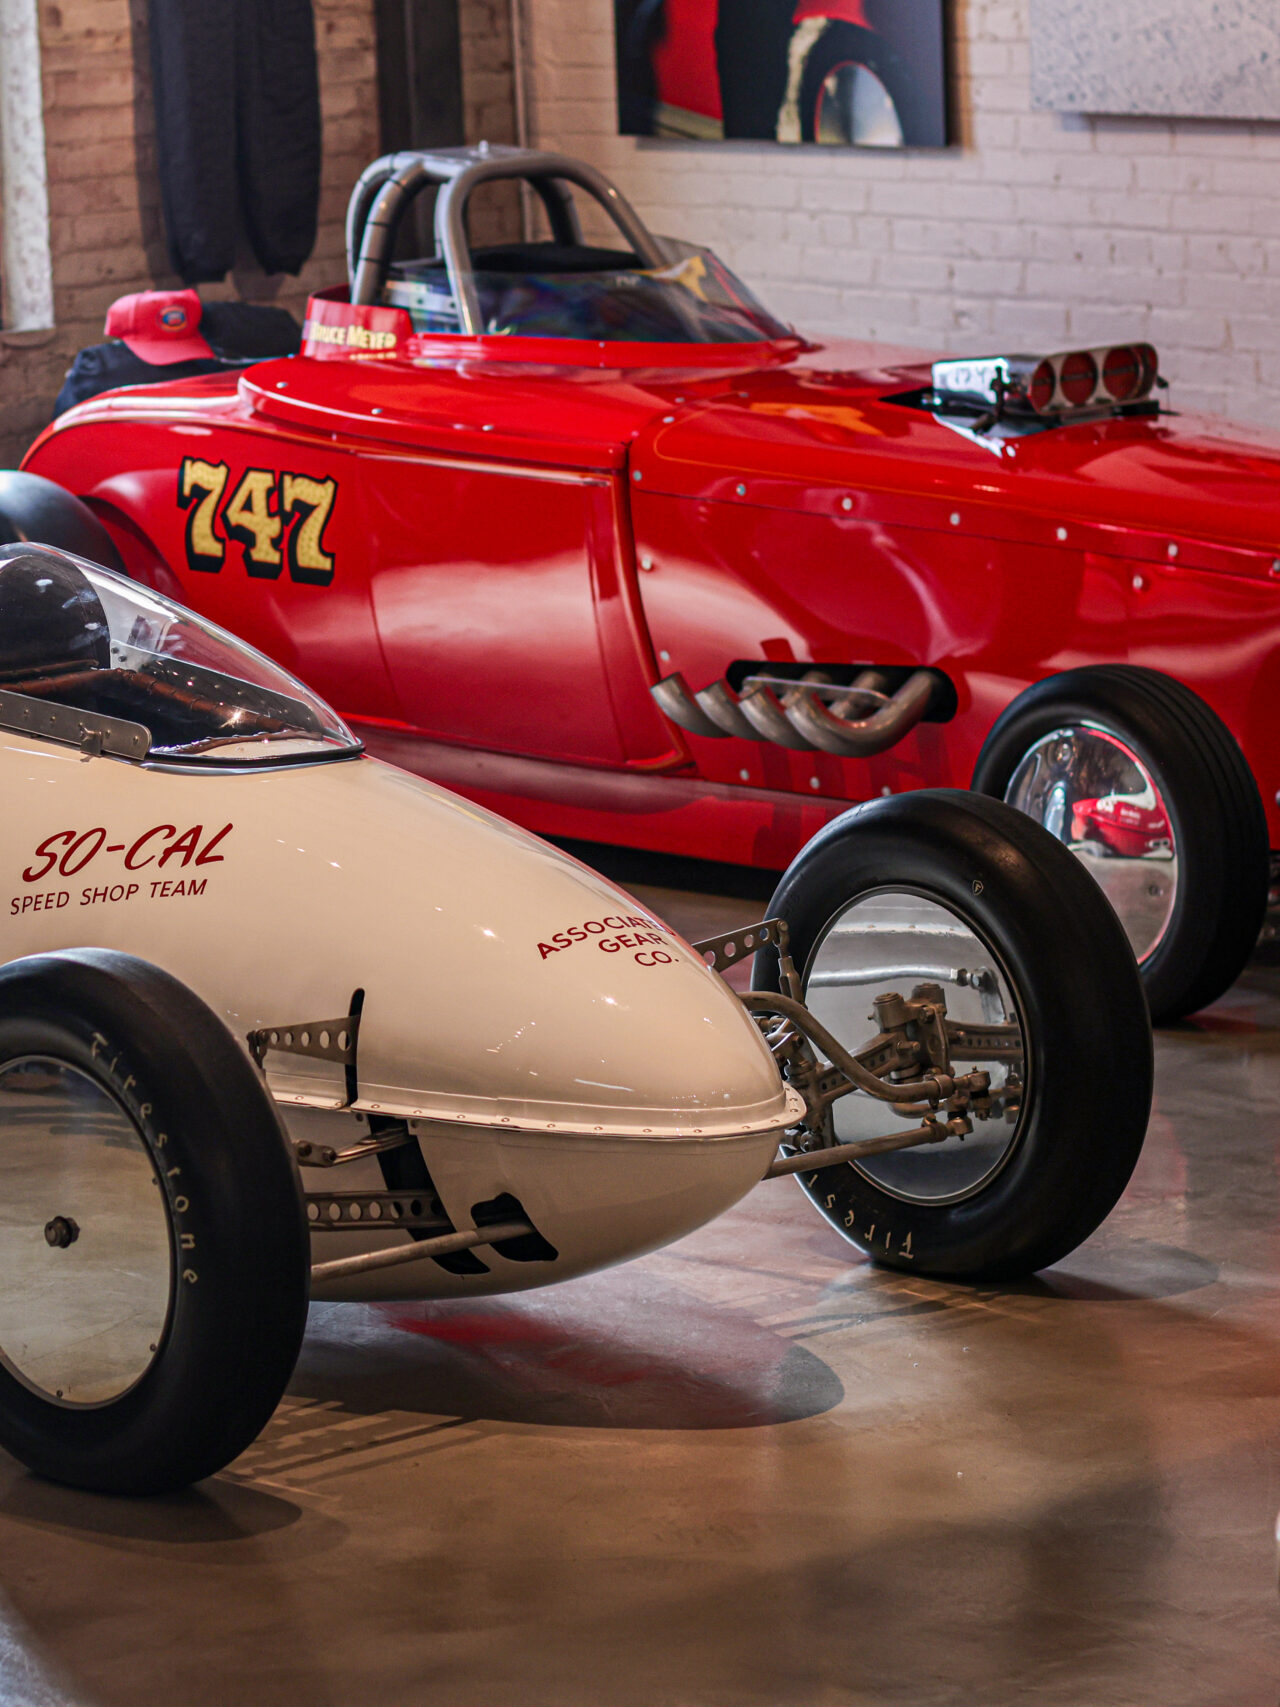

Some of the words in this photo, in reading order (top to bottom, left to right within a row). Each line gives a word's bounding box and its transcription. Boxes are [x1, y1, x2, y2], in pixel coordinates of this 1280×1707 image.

[177, 455, 338, 587] 747
[22, 822, 233, 882] SO-CAL
[10, 891, 70, 915] SPEED
[80, 883, 139, 906] SHOP
[150, 878, 208, 898] TEAM
[598, 932, 669, 953] GEAR
[806, 1173, 915, 1259] Firest
